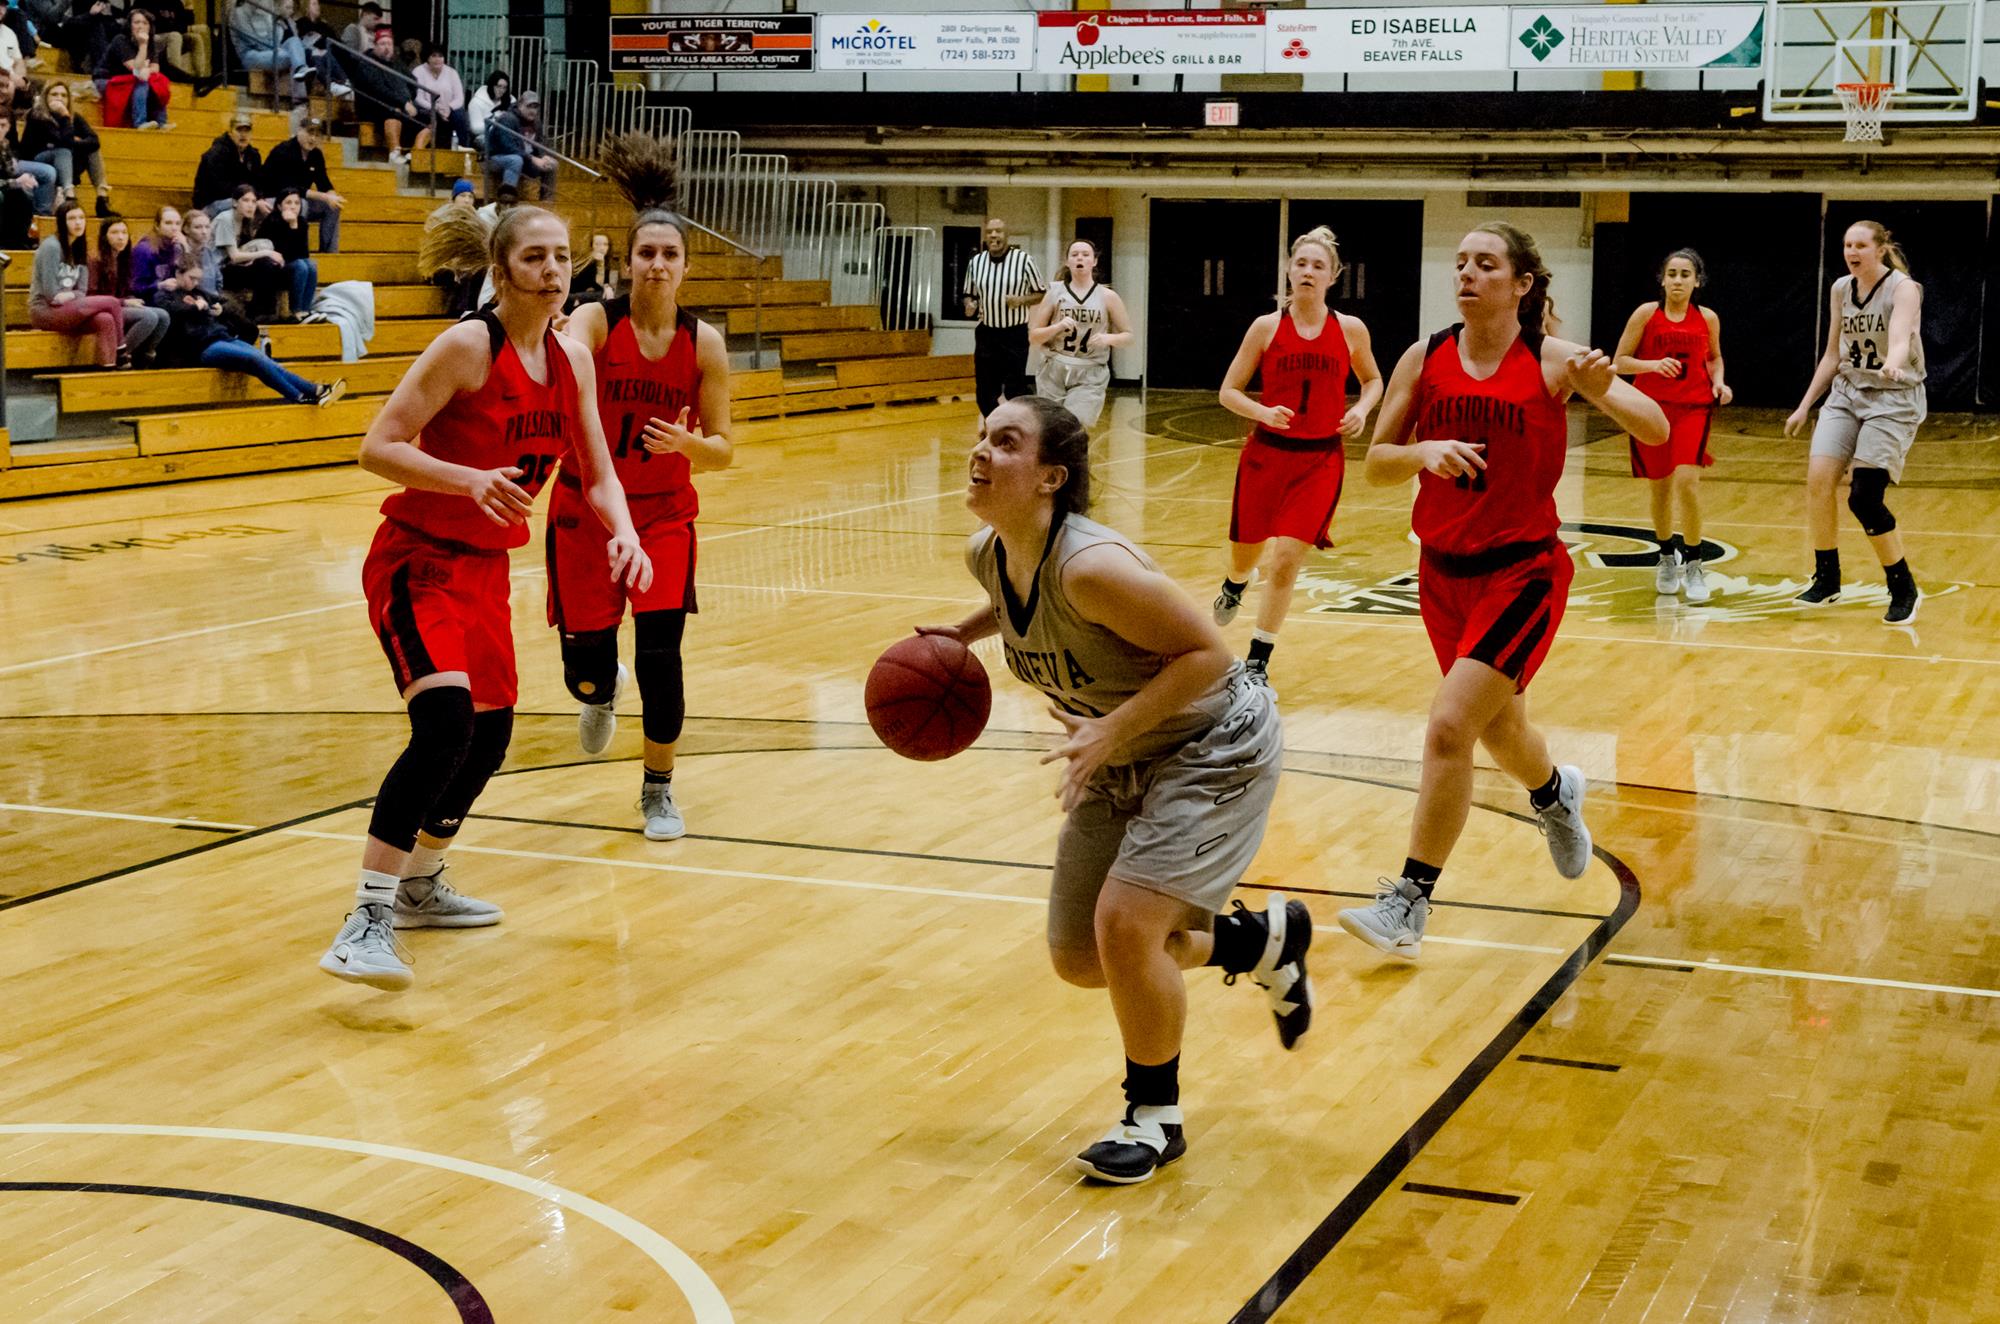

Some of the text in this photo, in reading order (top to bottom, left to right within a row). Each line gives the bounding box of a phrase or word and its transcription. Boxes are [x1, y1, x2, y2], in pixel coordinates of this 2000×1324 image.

[642, 19, 781, 30] YOU'RE IN TIGER TERRITORY
[1146, 14, 1166, 23] Town
[1197, 14, 1222, 23] Beaver
[960, 25, 1002, 34] Darlington
[1351, 18, 1476, 34] ED ISABELLA
[832, 36, 916, 49] MICROTEL
[937, 36, 963, 44] Beaver
[987, 36, 998, 44] PA
[1392, 39, 1408, 48] 7th
[762, 55, 800, 63] DISTRICT
[940, 49, 1016, 61] (724) 581-5273
[1059, 41, 1165, 69] Applebee's
[1172, 55, 1242, 64] GRILL & BAR
[1364, 50, 1463, 62] BEAVER FALLS
[1211, 105, 1233, 122] EXIT
[1842, 314, 1885, 334] ENEVA
[1849, 338, 1883, 370] 42
[1298, 379, 1311, 415] 1
[1428, 395, 1525, 436] PRESIDENTS
